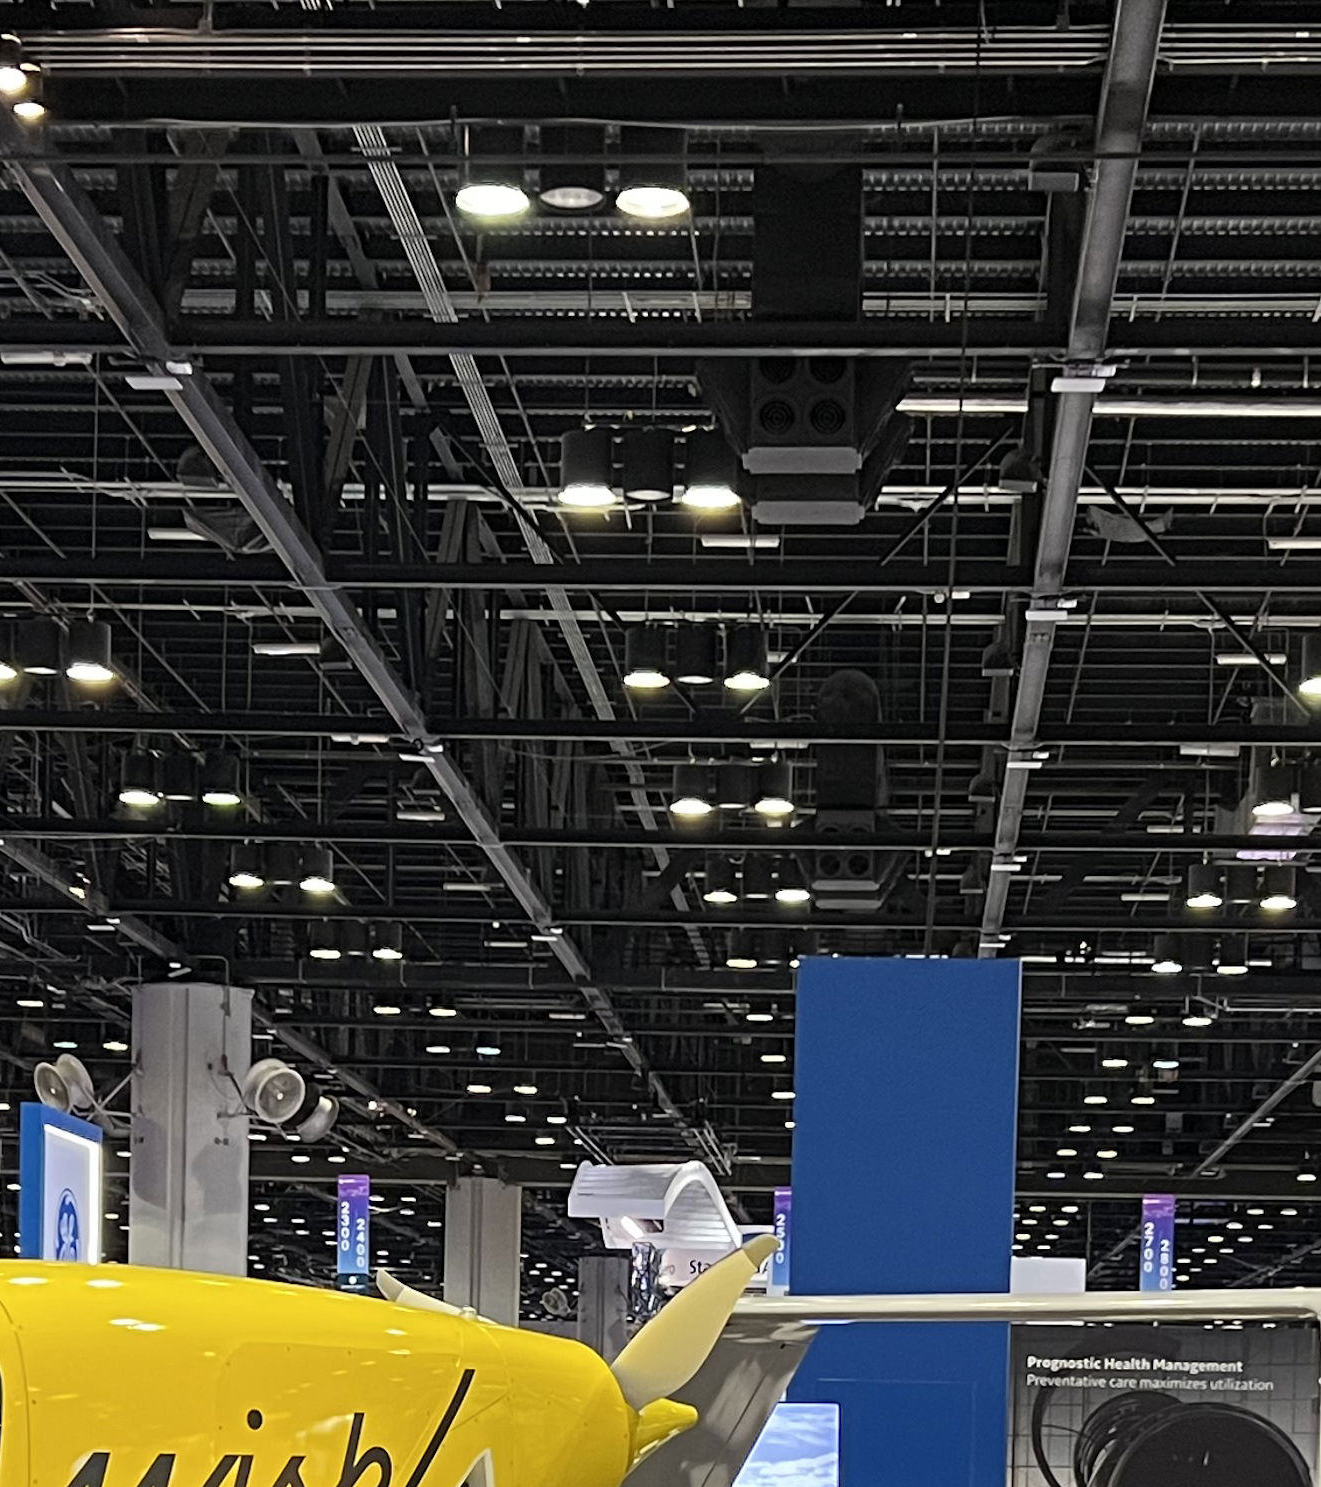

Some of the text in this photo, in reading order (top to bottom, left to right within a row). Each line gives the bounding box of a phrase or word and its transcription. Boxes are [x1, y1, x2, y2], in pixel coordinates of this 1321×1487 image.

[340, 1201, 350, 1251] 2300
[356, 1218, 365, 1268] 2400
[1143, 1222, 1155, 1273] 2700
[1159, 1239, 1170, 1290] 2800
[1026, 1374, 1274, 1391] Preventative care maximizes utilization
[1027, 1356, 1244, 1375] Prognostic Health Management
